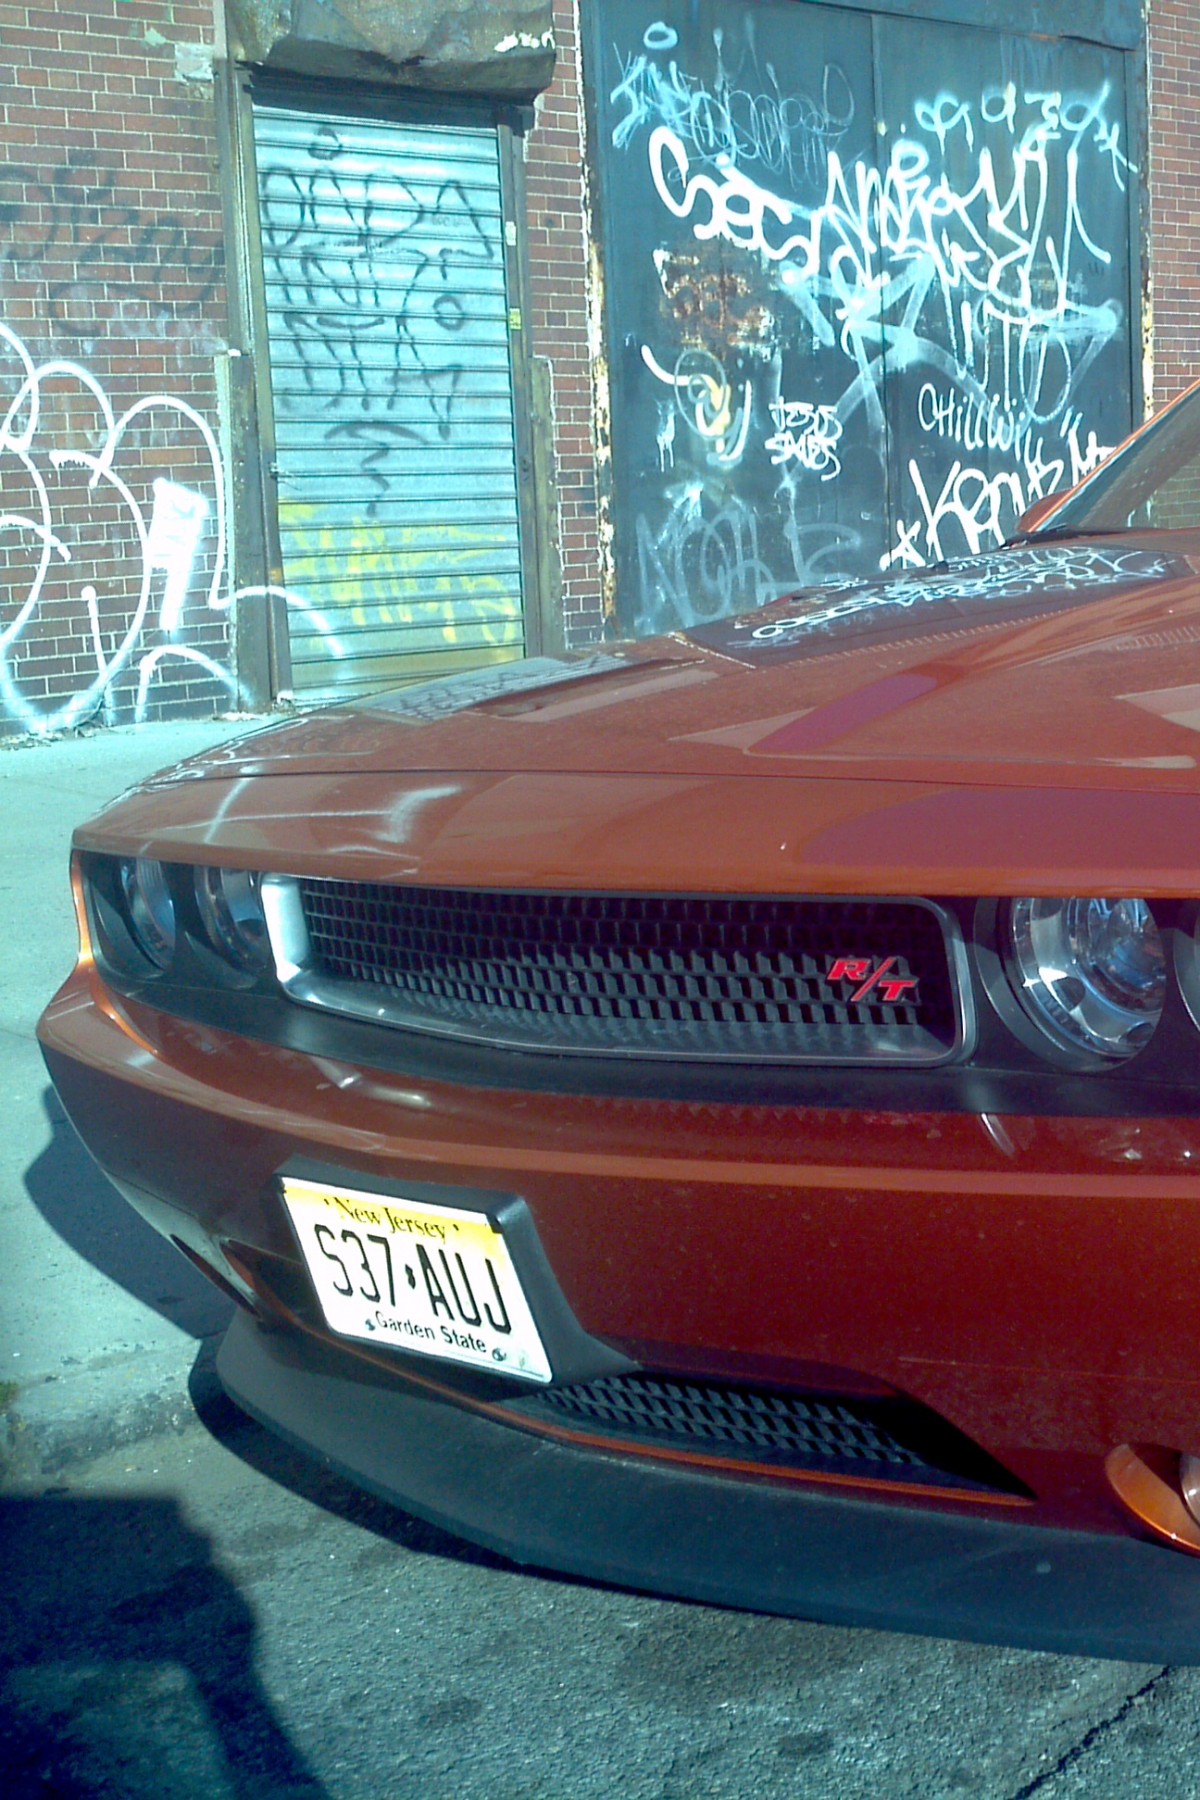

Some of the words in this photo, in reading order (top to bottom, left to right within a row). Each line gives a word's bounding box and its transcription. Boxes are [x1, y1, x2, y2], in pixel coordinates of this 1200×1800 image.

[827, 957, 918, 1002] R/T
[335, 1197, 381, 1226] New
[386, 1207, 447, 1244] Jersey
[375, 1311, 436, 1340] Garden
[442, 1326, 487, 1354] State
